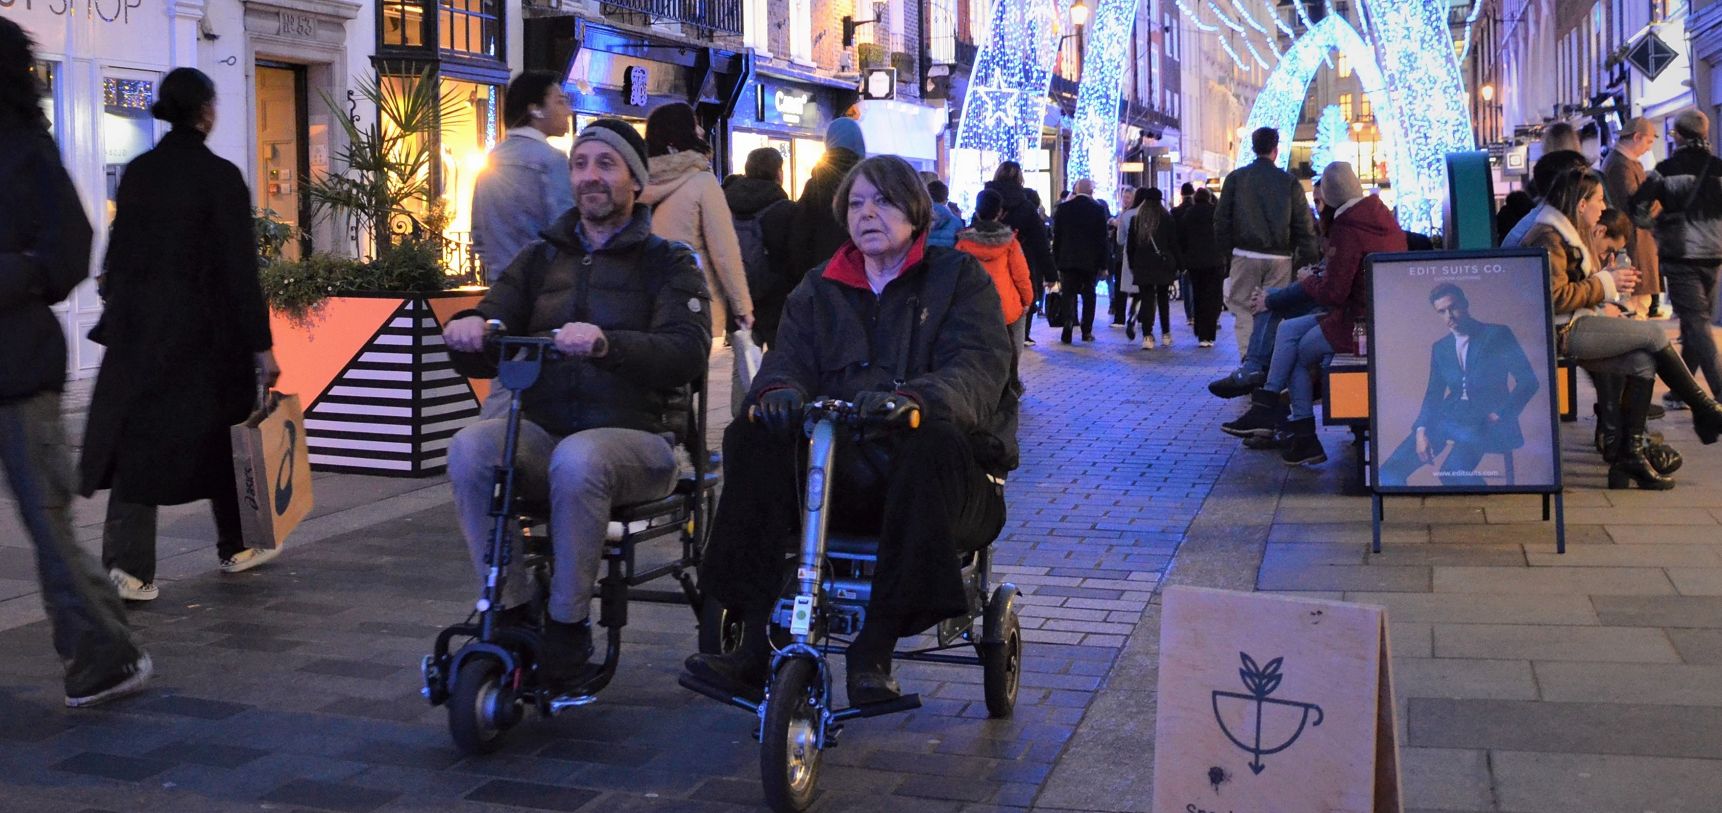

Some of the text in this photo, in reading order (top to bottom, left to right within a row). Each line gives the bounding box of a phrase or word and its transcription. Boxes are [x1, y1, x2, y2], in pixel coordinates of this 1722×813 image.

[1409, 264, 1505, 276] EDIT SUITS CO.
